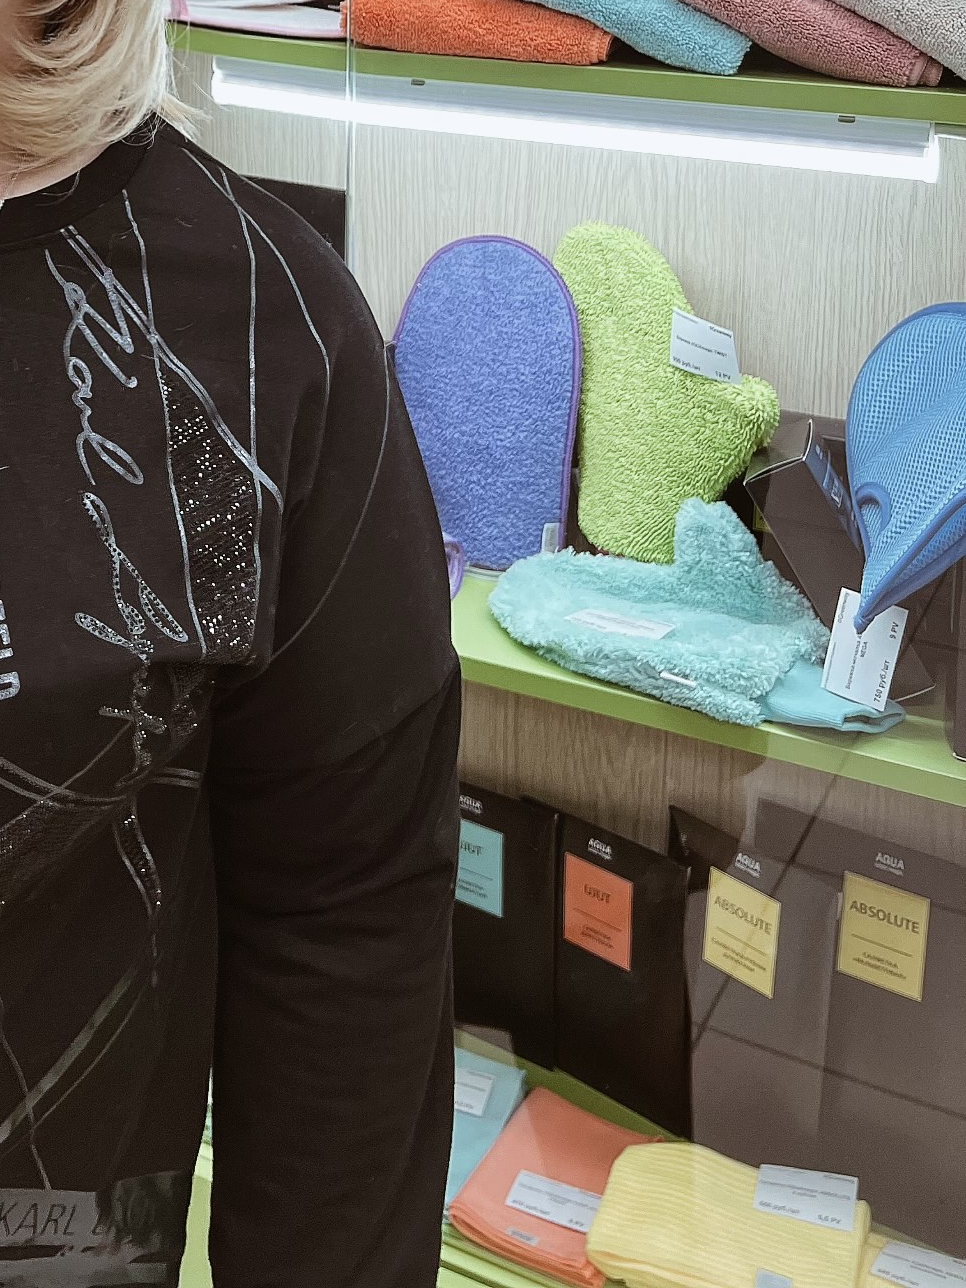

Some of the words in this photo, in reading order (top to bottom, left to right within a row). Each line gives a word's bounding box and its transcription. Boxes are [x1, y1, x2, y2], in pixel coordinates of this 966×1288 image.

[890, 621, 899, 634] PV
[878, 660, 890, 688] руб./шт
[874, 688, 883, 703] 750
[736, 853, 762, 872] AQUA
[875, 852, 905, 870] AQUA
[714, 896, 773, 935] ABSOLUTE
[849, 900, 920, 935] ABSOLUTE
